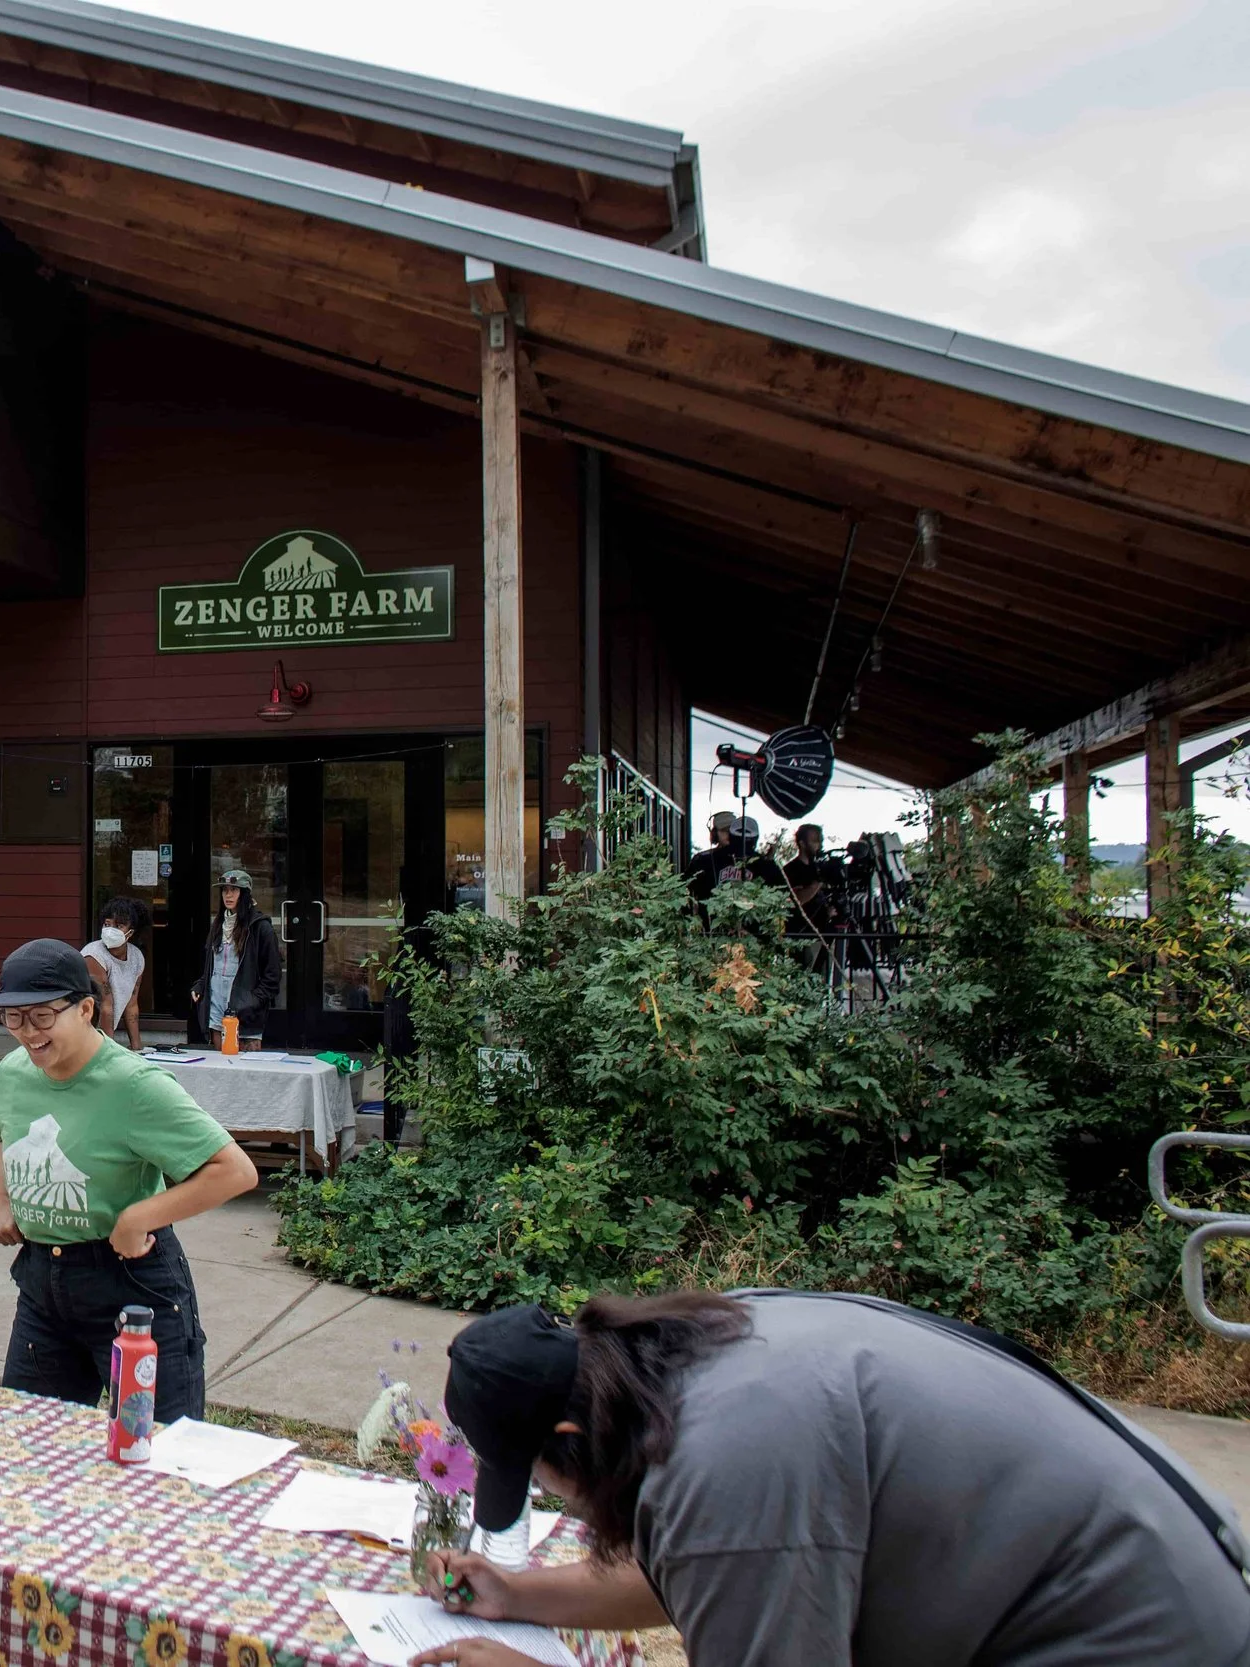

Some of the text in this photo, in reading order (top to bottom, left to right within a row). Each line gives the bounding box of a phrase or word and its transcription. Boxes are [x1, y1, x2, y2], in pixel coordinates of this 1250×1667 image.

[174, 586, 434, 626] ZENGER FARM
[257, 621, 345, 638] WELCOME
[116, 756, 151, 767] 11705
[49, 1209, 90, 1229] farm
